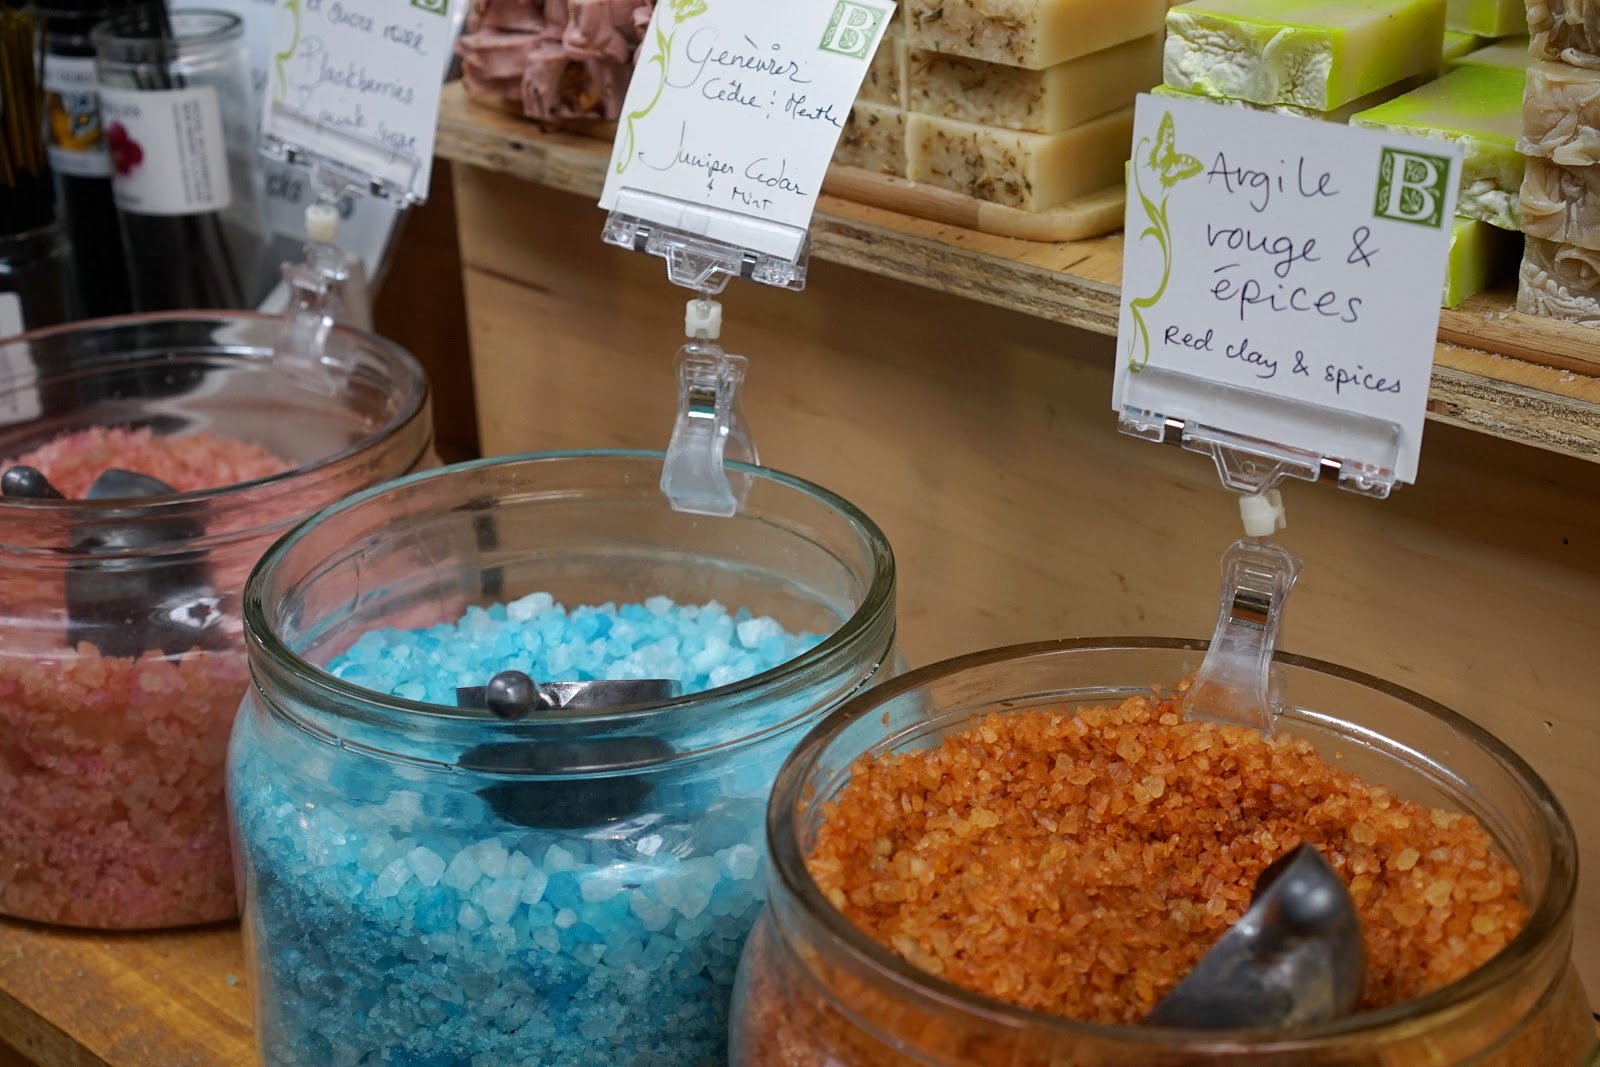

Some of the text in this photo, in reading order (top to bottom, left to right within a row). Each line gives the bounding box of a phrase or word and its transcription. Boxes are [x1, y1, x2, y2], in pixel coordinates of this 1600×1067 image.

[638, 120, 808, 196] Juniper Cedar
[1207, 151, 1341, 212] Argile
[1381, 150, 1442, 224] B
[1206, 223, 1381, 278] rouge &
[1209, 264, 1363, 324] épices
[1163, 325, 1401, 395] Red clay & spices
